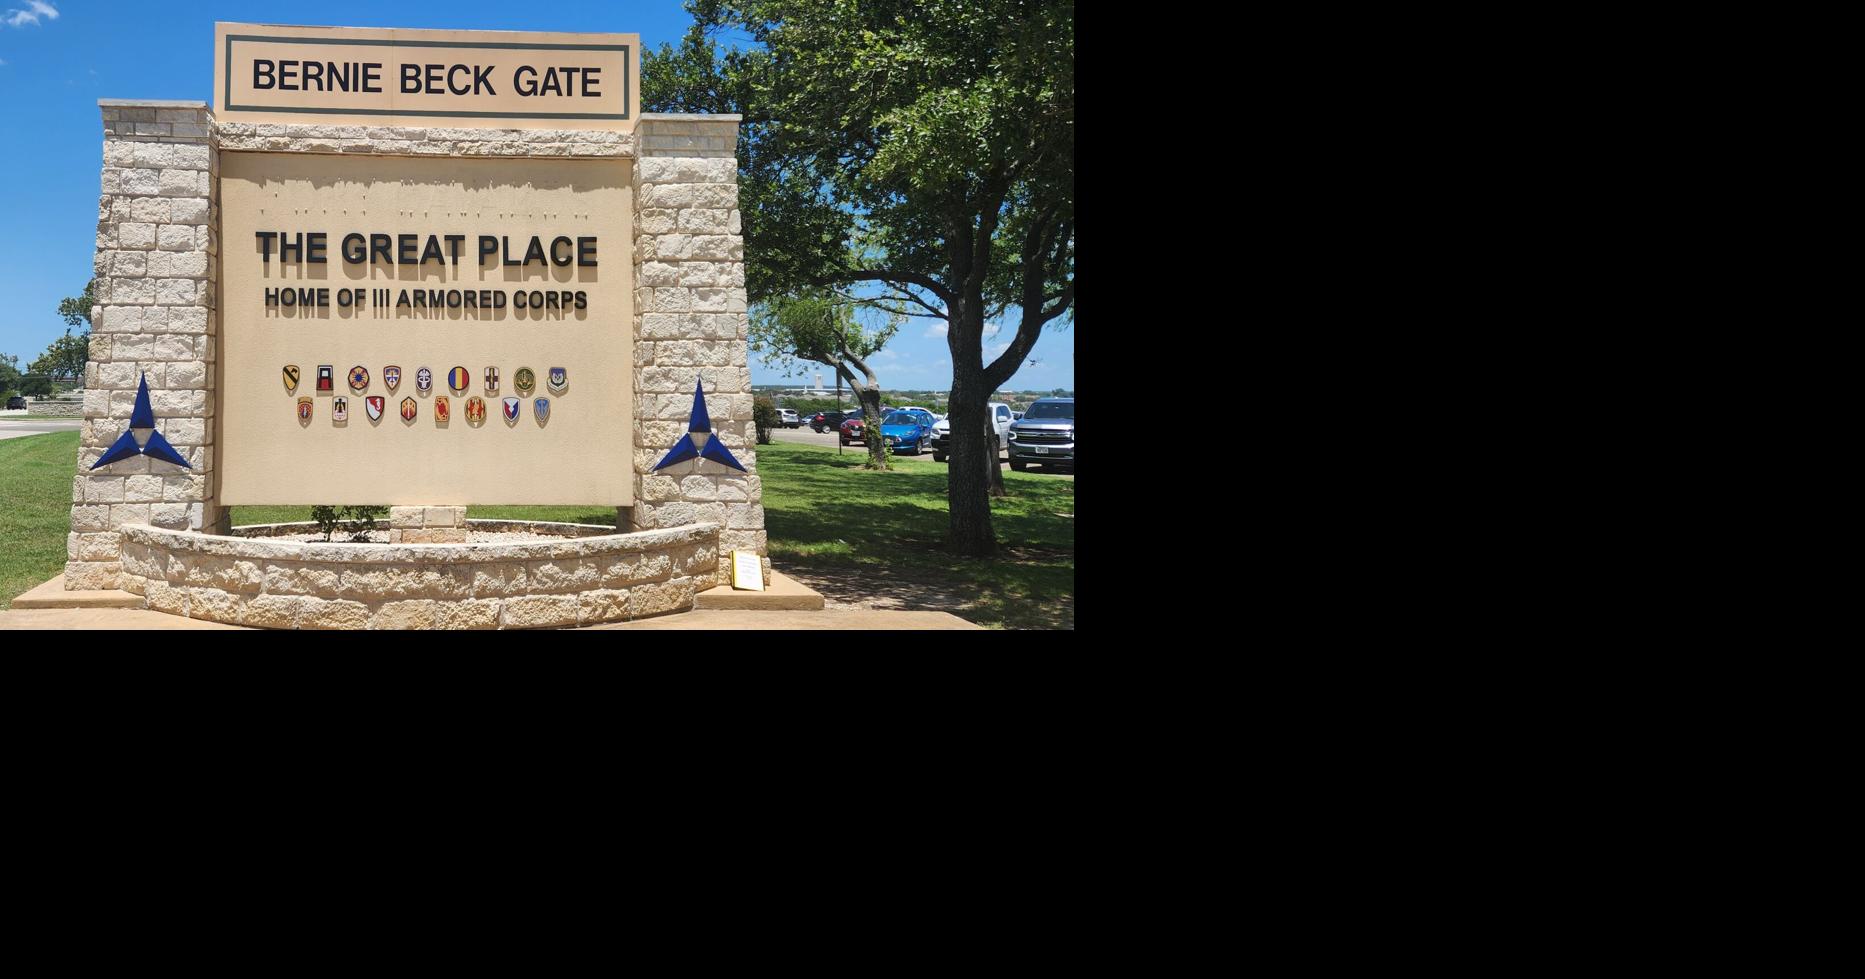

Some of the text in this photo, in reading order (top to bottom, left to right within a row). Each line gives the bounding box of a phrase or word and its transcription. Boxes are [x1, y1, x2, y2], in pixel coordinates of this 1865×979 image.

[253, 59, 602, 97] BERNIE BECK GATE
[255, 231, 598, 267] THE GREAT PLACE
[264, 287, 588, 310] HOME OF III ARMORED CORPS
